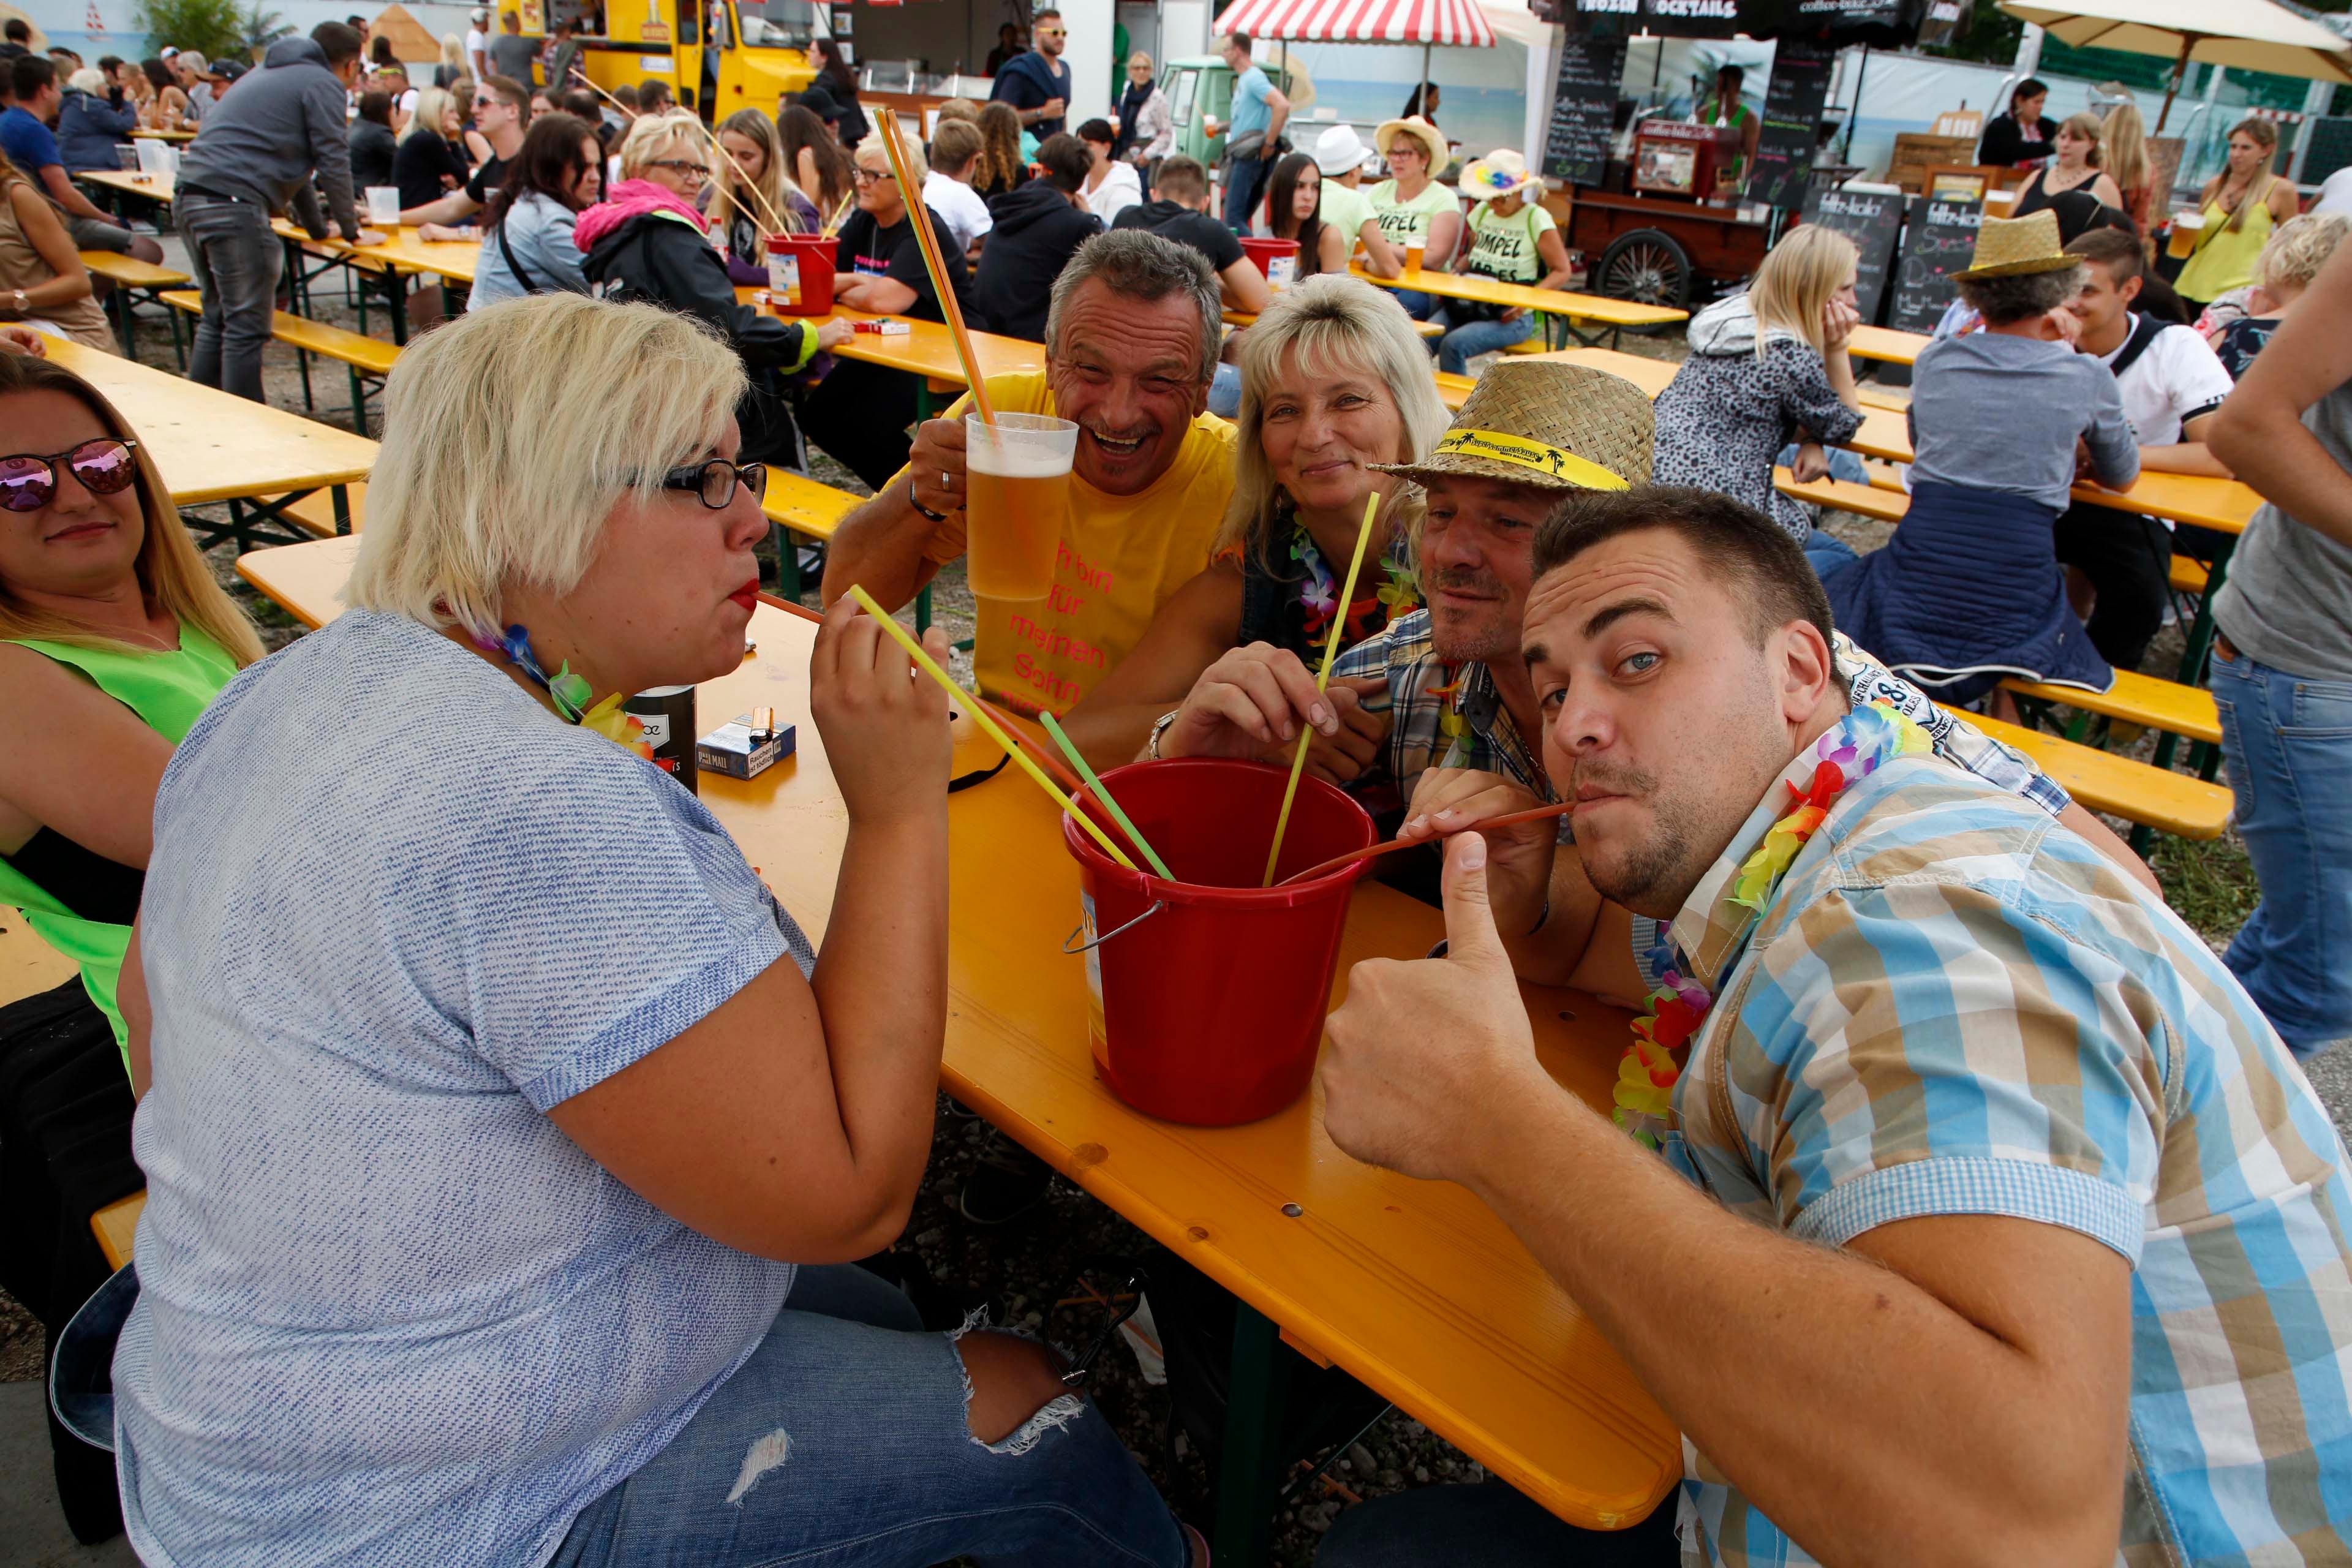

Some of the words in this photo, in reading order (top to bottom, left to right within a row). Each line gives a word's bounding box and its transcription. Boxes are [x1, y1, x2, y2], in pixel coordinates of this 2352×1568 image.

[1077, 554, 1114, 594] bin
[1046, 584, 1084, 616] für
[1009, 614, 1106, 669] meinen
[1014, 654, 1080, 705] Sohn
[1902, 696, 1921, 717] OLES
[698, 751, 711, 765] PALL
[712, 754, 727, 769] MALL
[749, 747, 772, 764] Rauchen
[756, 755, 774, 769] tödlich
